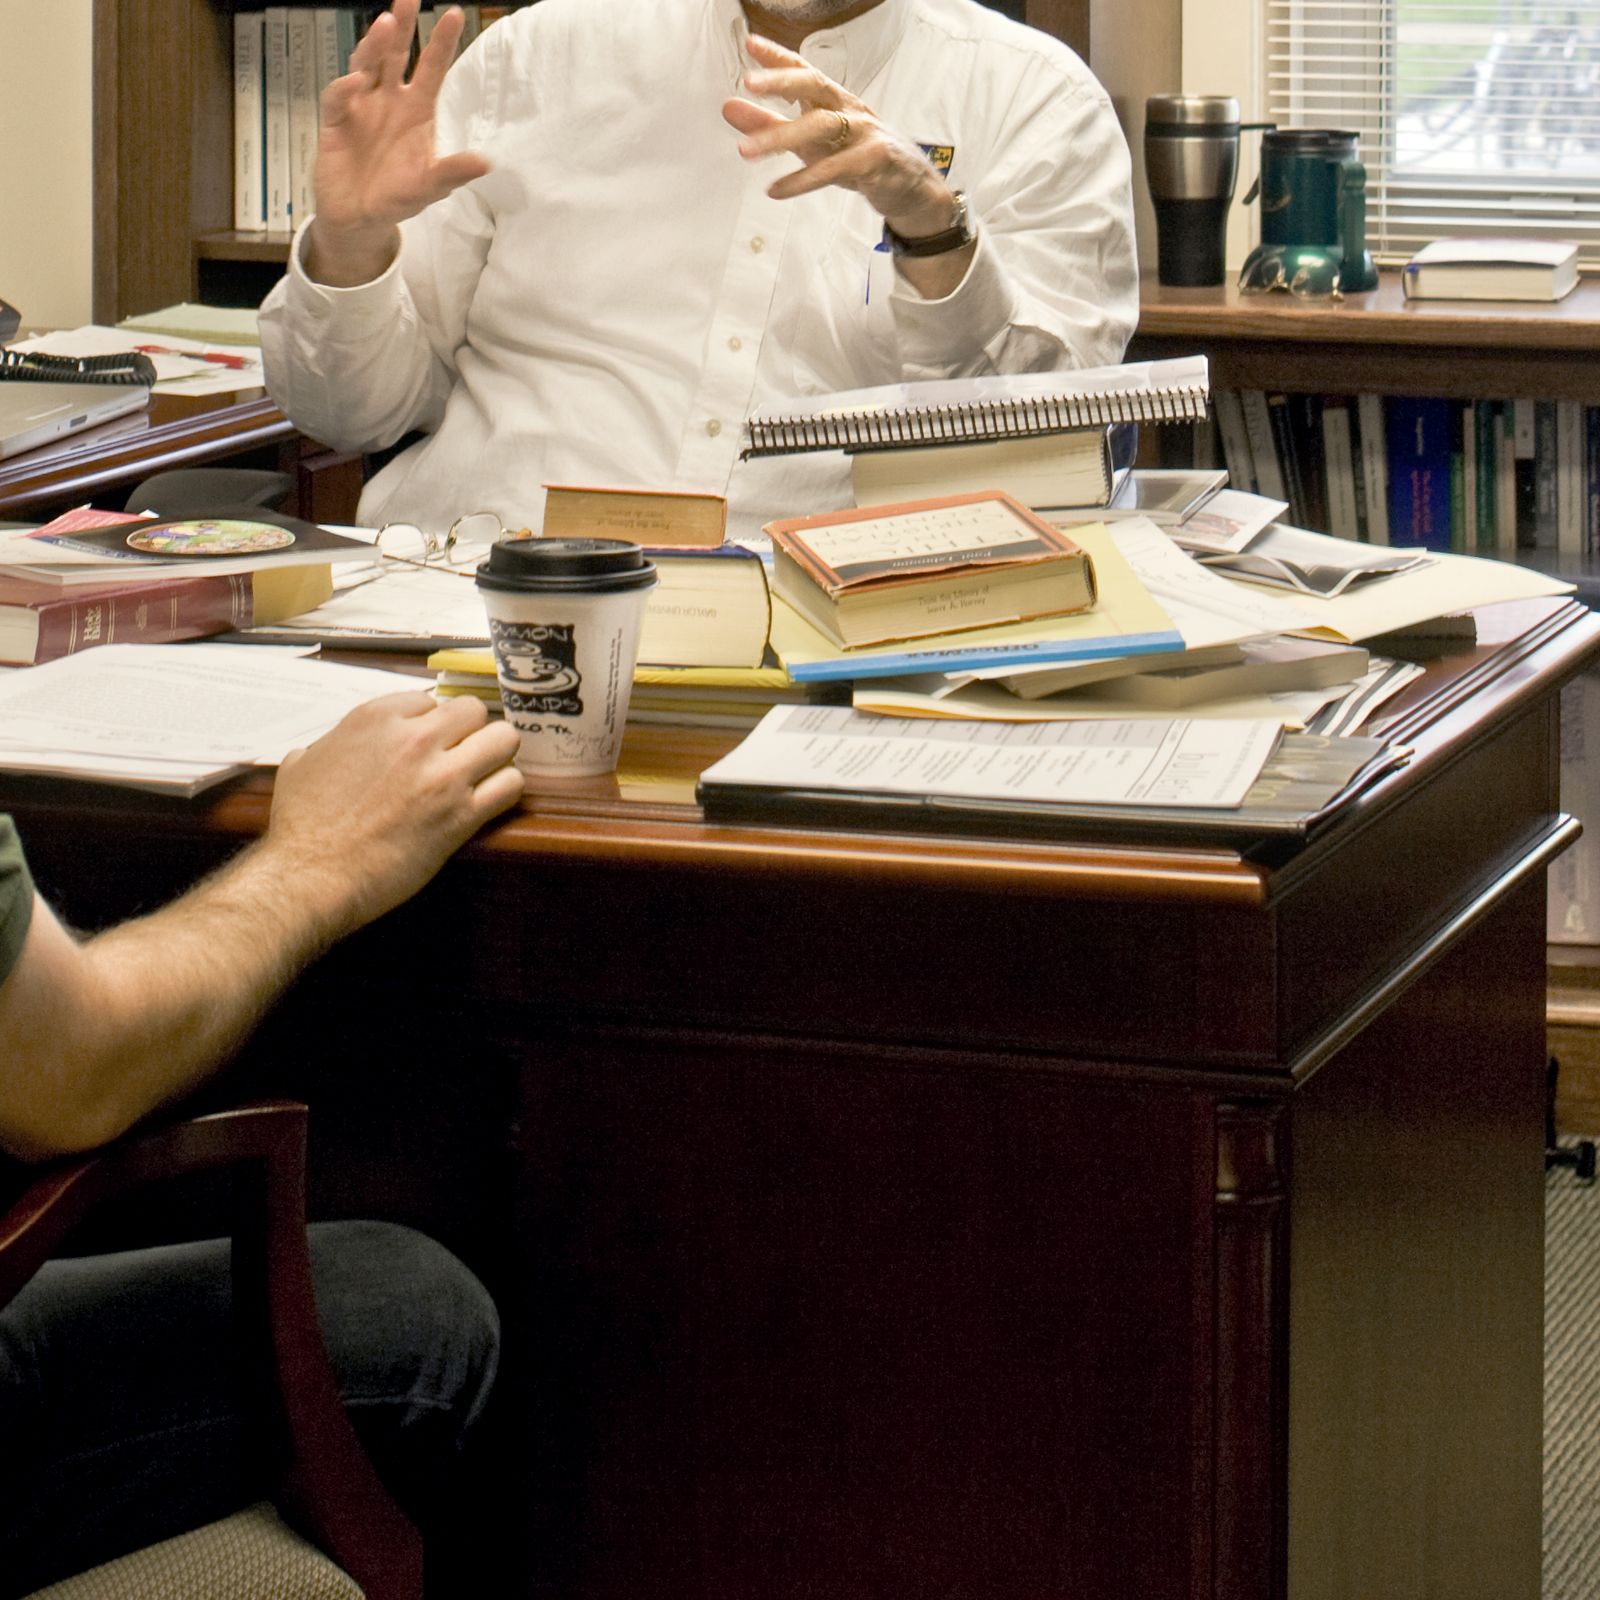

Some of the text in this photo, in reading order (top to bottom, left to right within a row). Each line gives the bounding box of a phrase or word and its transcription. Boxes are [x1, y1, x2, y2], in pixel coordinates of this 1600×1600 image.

[238, 34, 250, 93] ETHICS
[272, 22, 283, 78] ETHICS
[293, 24, 305, 100] DOCTRINE
[82, 608, 93, 641] Holy
[91, 606, 101, 640] Bible
[491, 620, 569, 642] OMMON
